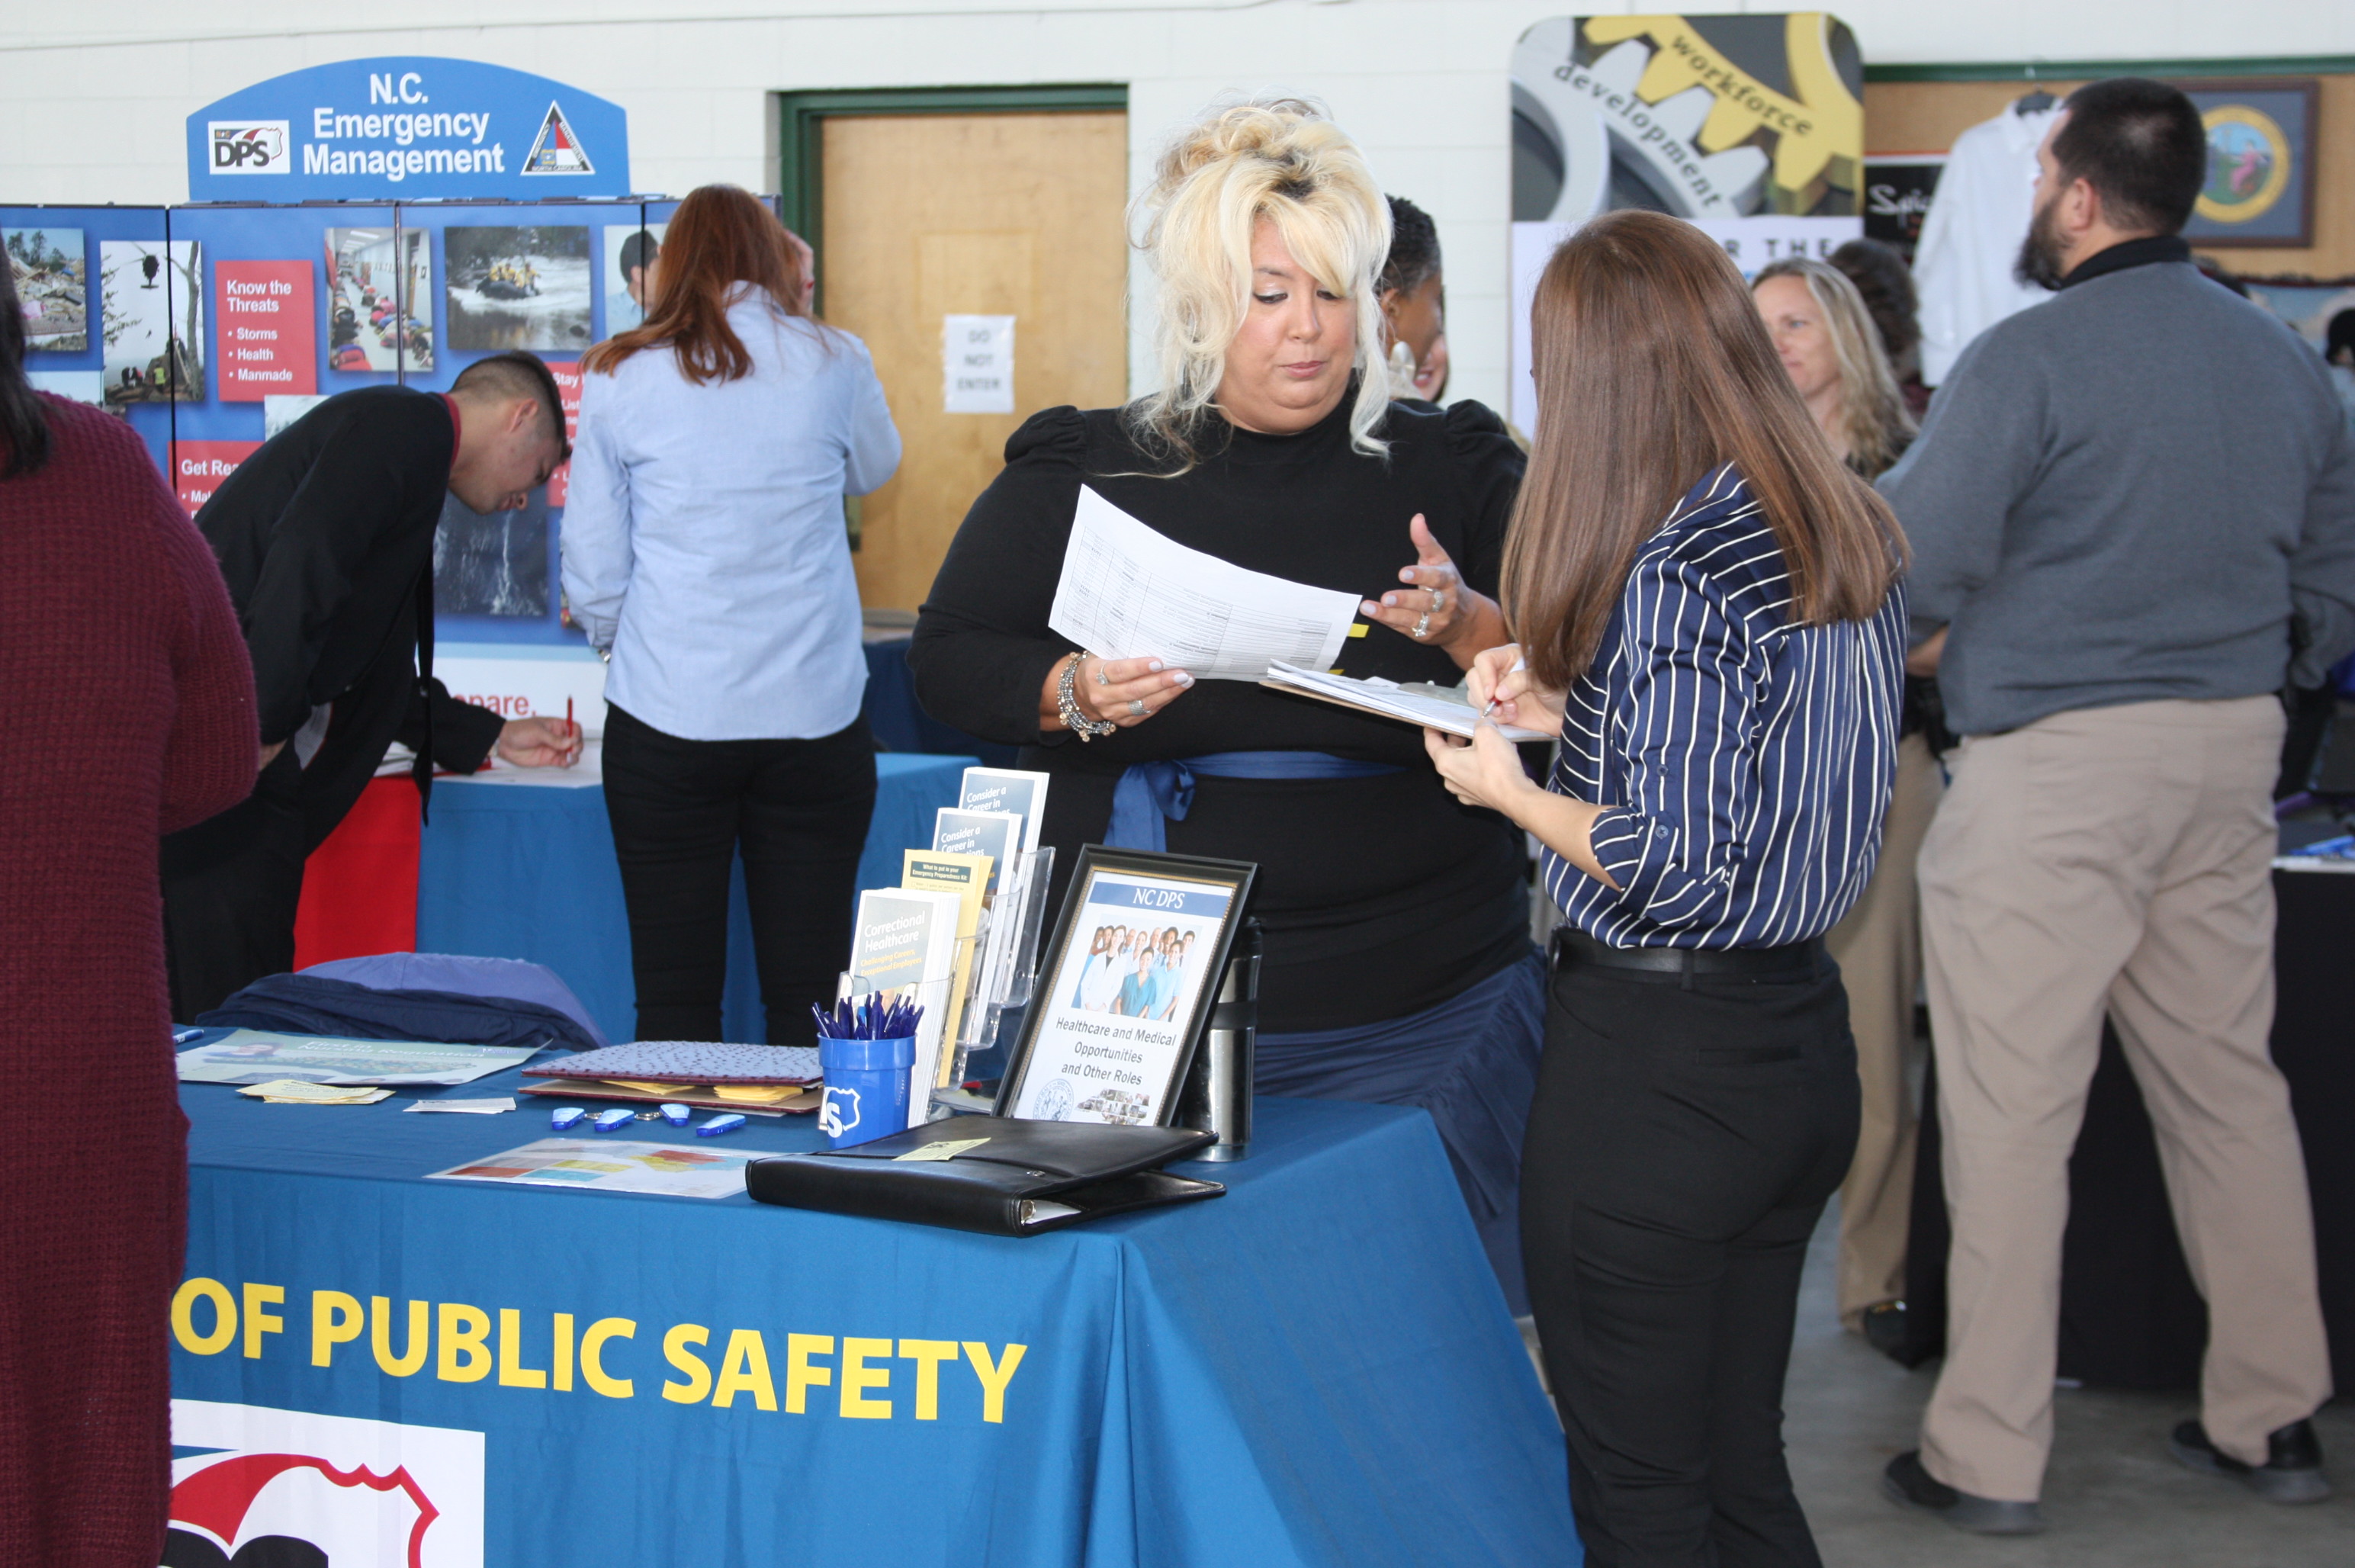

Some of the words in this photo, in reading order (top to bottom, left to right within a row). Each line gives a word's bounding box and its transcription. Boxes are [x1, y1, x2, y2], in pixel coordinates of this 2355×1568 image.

[370, 72, 429, 104] N.C.
[1672, 37, 1812, 135] workforce
[313, 108, 490, 145] Emergency
[1553, 61, 1720, 207] development
[214, 141, 270, 167] DPS
[304, 143, 505, 182] Management
[1765, 239, 1831, 258] THE
[227, 279, 266, 295] Know
[270, 280, 291, 295] the
[227, 297, 279, 313] Threats
[236, 327, 278, 340] Storms
[968, 329, 990, 342] DO
[237, 348, 273, 361] Health
[964, 354, 994, 367] NOT
[238, 368, 293, 381] Manmade
[553, 372, 579, 387] Stay
[957, 378, 1001, 390] ENTER
[182, 459, 207, 475] Get
[967, 788, 1000, 803] Consider
[993, 798, 1001, 808] in
[941, 827, 974, 843] Consider
[942, 840, 966, 853] Career
[967, 839, 975, 848] in
[912, 869, 933, 878] Emergency
[934, 872, 960, 880] Preparedness
[1133, 888, 1156, 905] NC
[1156, 891, 1185, 909] DPS
[864, 910, 925, 937] Correctional
[865, 930, 919, 953] Healthcare
[861, 953, 894, 967] Challenging
[861, 963, 893, 976] Exceptional
[893, 958, 922, 969] Employees
[1055, 1017, 1110, 1036] Healthcare
[1112, 1028, 1133, 1039] and
[1134, 1029, 1177, 1046] Medical
[1075, 1041, 1143, 1063] Opportunities
[1062, 1063, 1082, 1075] and
[1083, 1065, 1111, 1080] Other
[1113, 1069, 1142, 1085] Roles
[171, 1277, 284, 1359] OF
[311, 1290, 636, 1399] PUBLIC
[662, 1323, 1028, 1423] SAFETY
